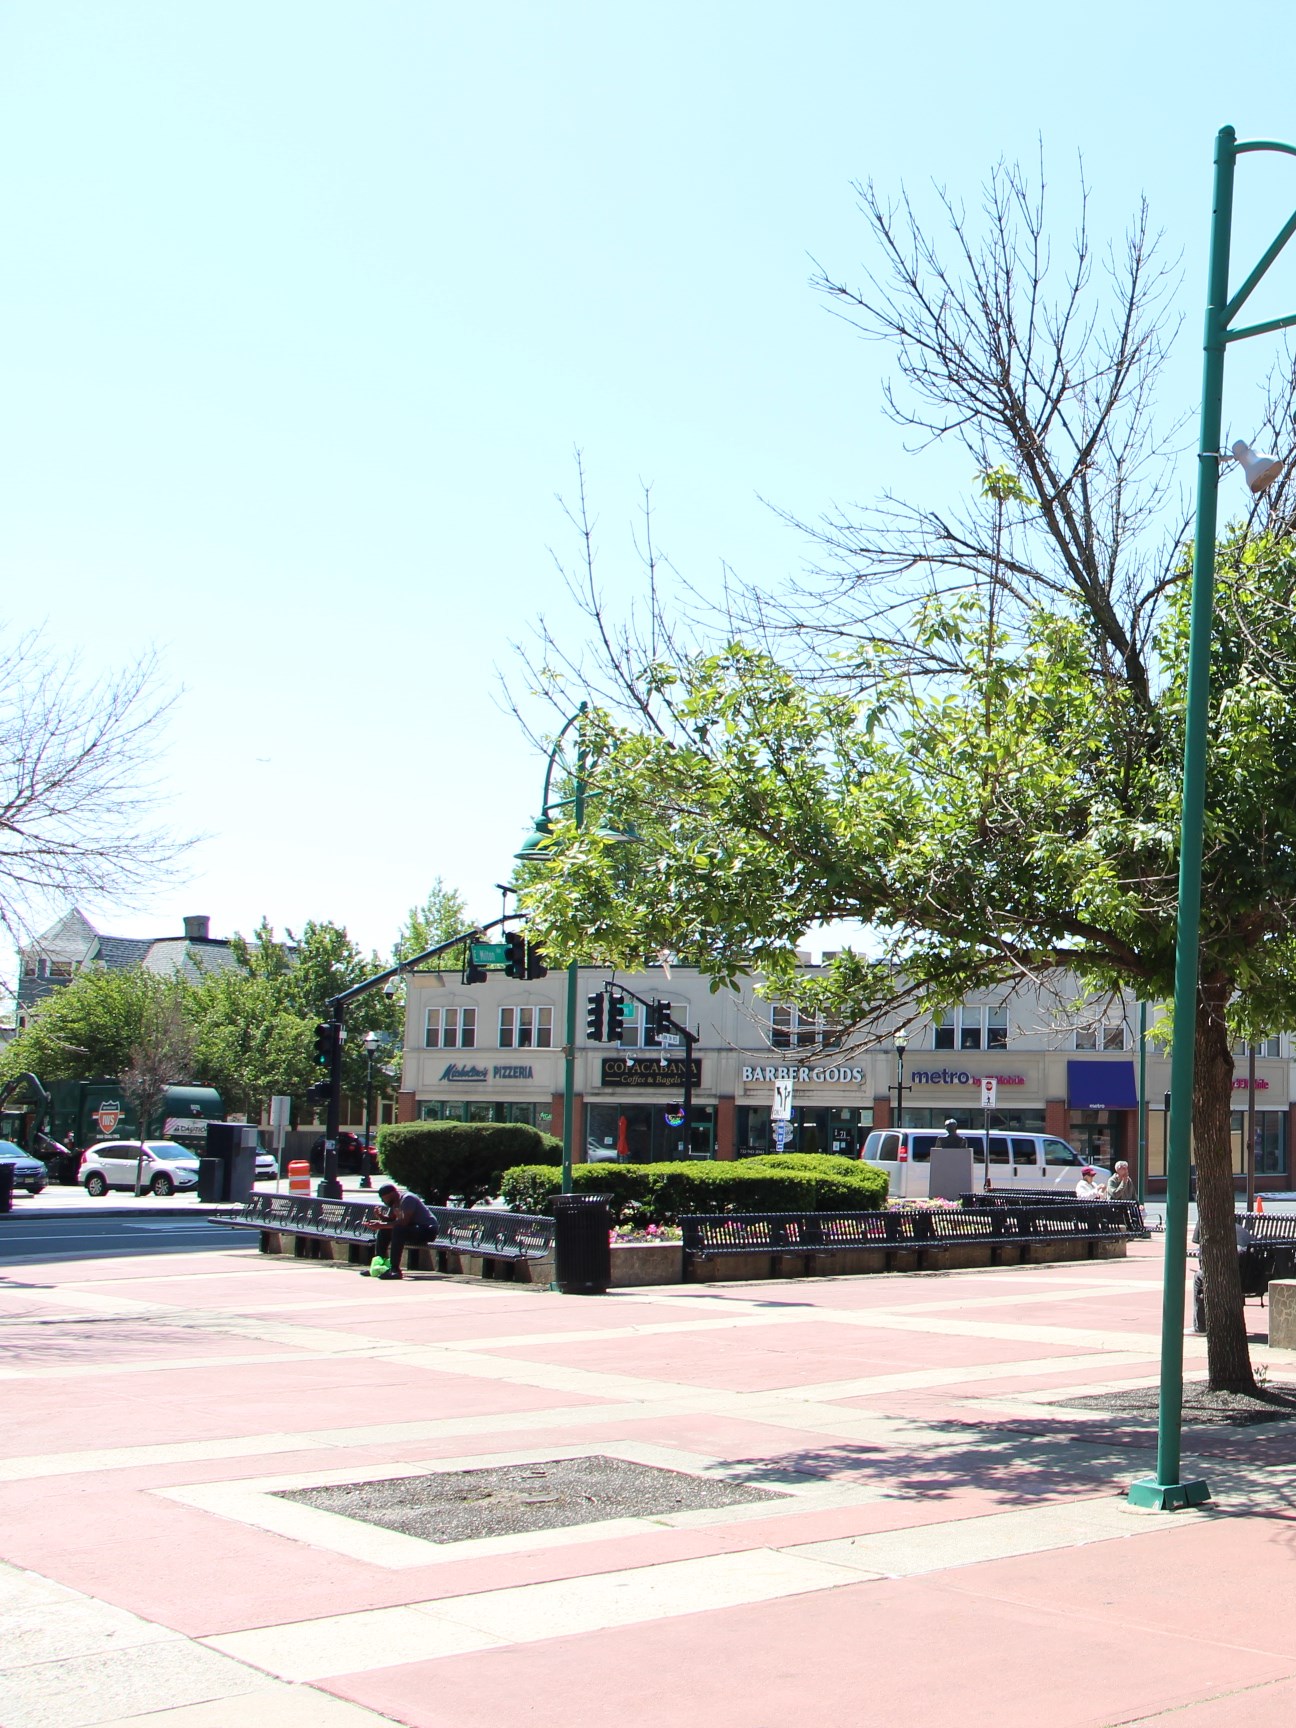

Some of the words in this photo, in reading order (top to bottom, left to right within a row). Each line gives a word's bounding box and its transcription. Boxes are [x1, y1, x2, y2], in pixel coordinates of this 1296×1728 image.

[493, 1065, 534, 1079] PIZZERIA
[742, 1066, 810, 1082] BARBER
[812, 1067, 863, 1083] GODS
[911, 1068, 970, 1084] metro
[621, 1075, 645, 1085] Coffee
[655, 1076, 681, 1086] Bagels
[181, 1124, 207, 1133] CAUTIO
